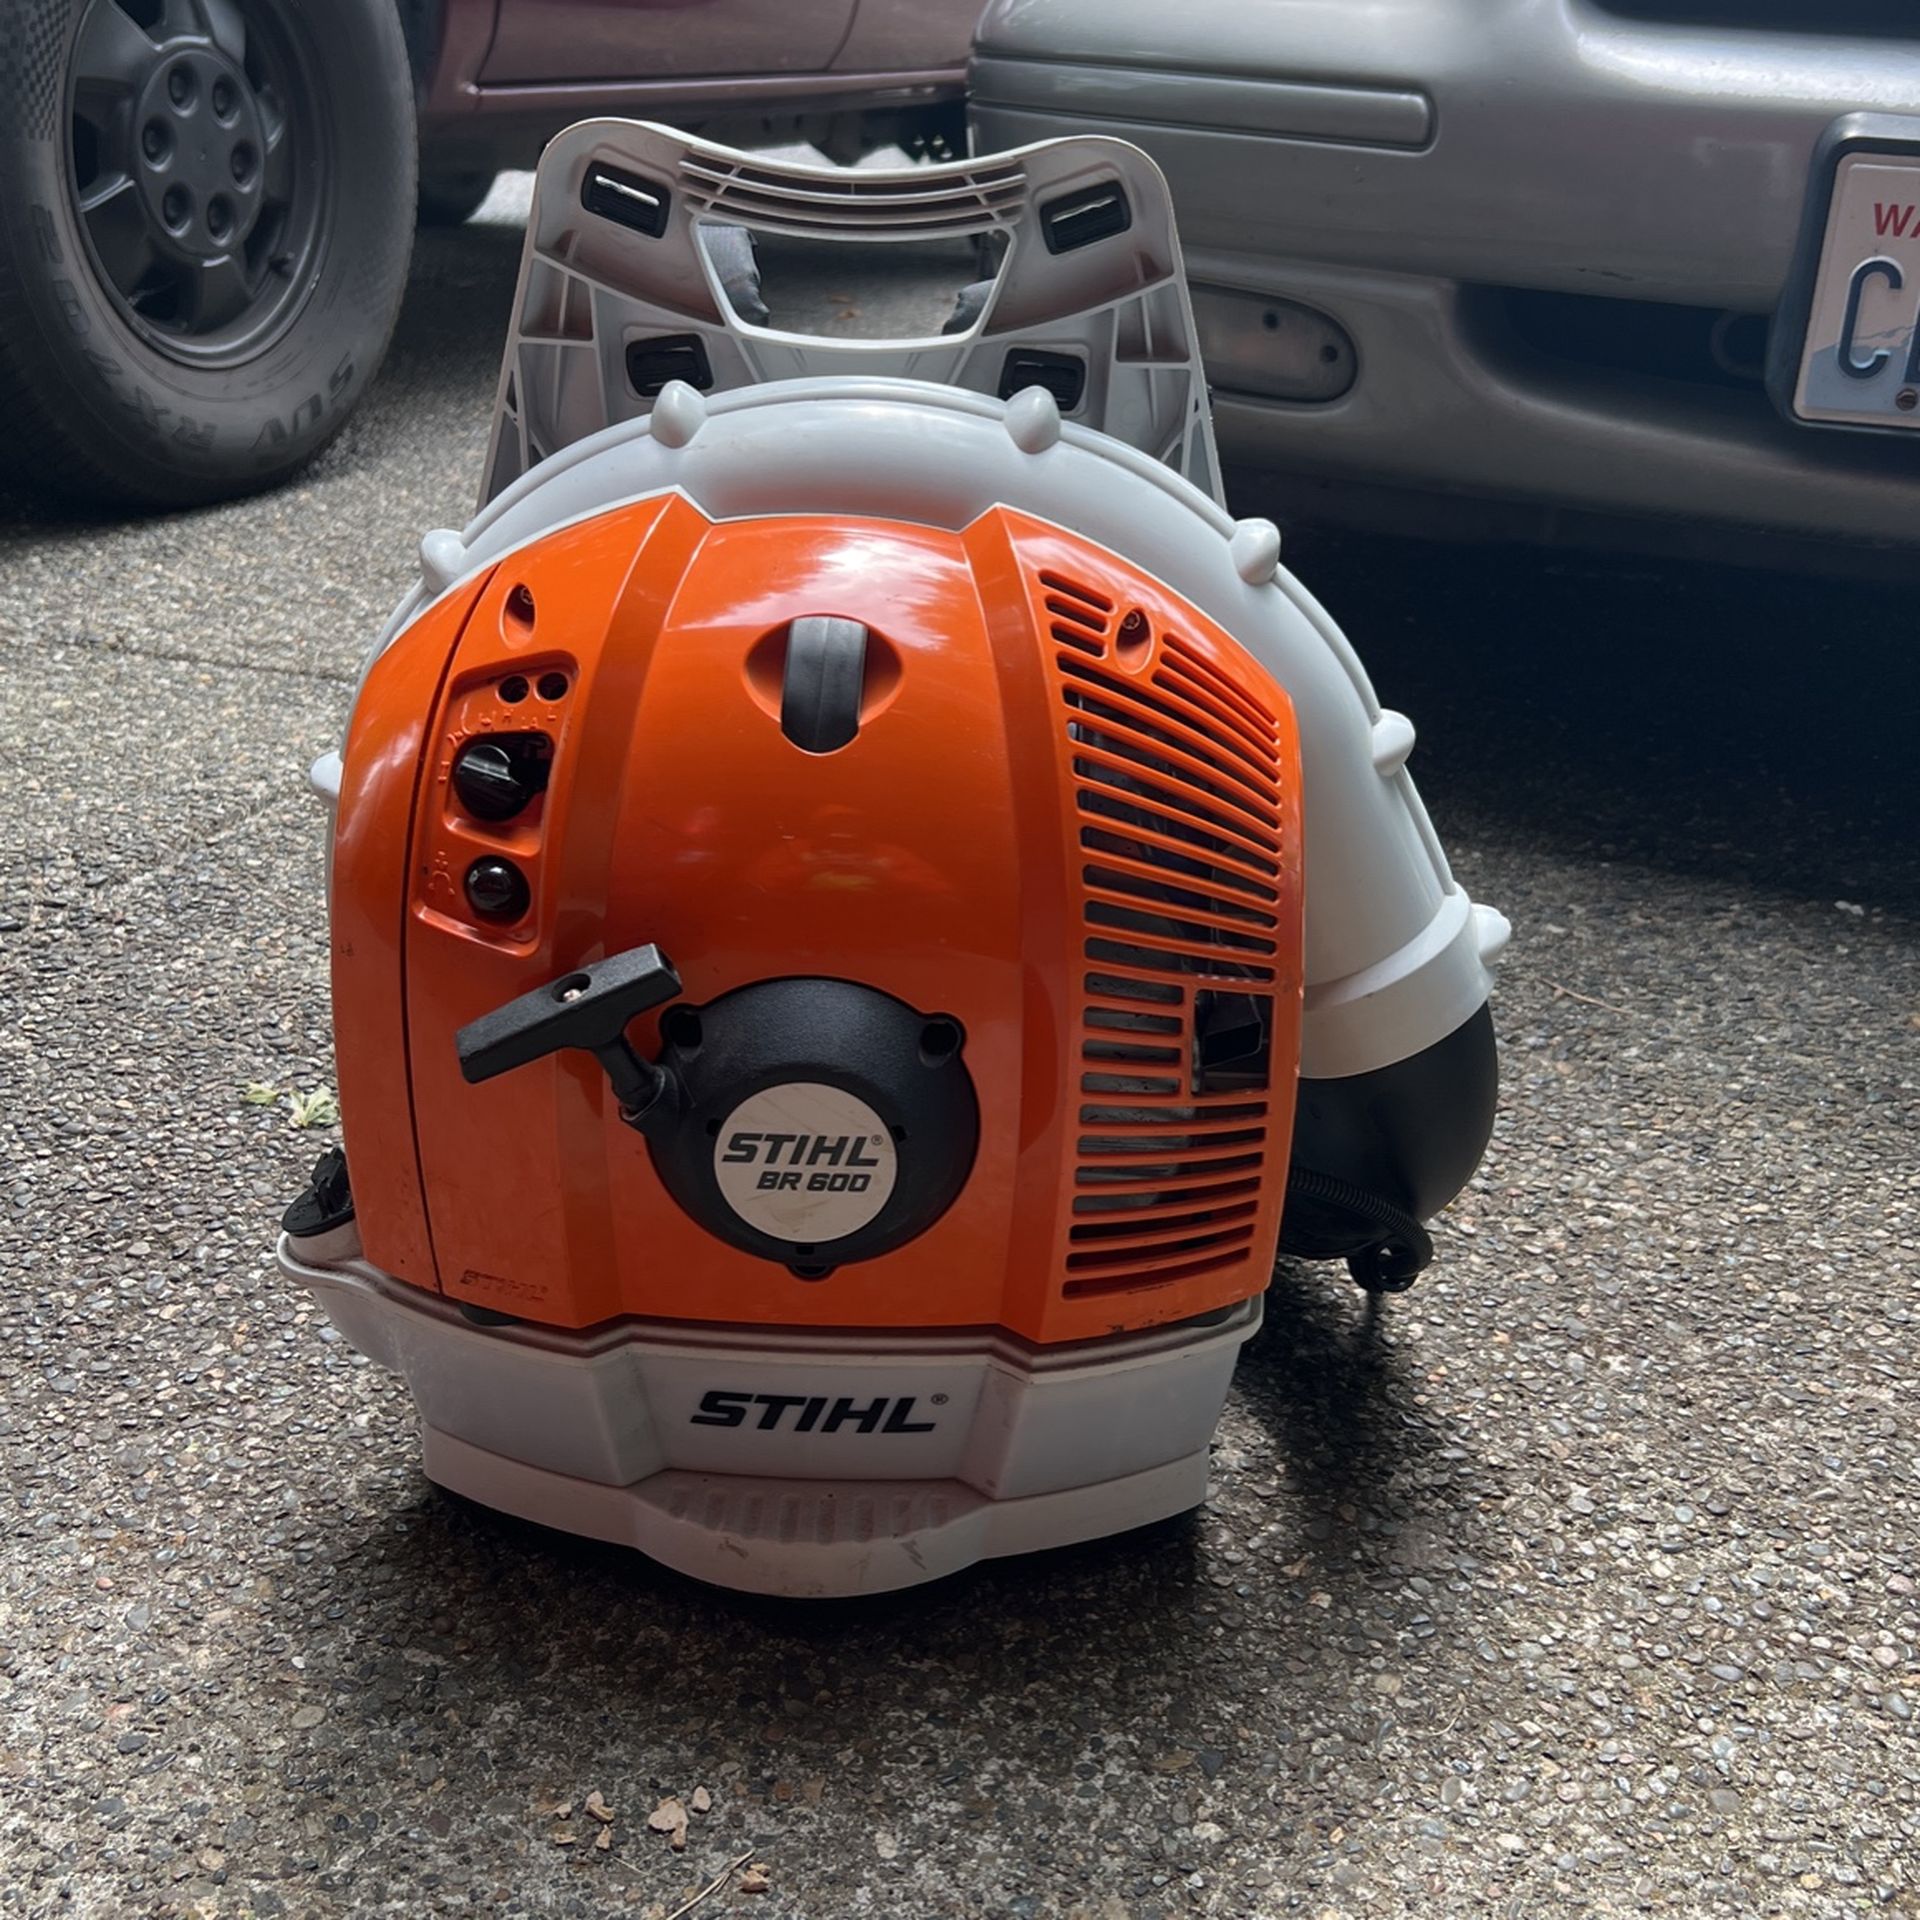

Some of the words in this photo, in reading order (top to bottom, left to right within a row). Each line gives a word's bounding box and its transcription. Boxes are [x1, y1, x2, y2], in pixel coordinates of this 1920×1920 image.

[1874, 202, 1920, 239] W
[1837, 255, 1920, 384] C
[250, 352, 354, 453] SUV
[756, 1171, 803, 1191] BR
[806, 1173, 872, 1192] 600
